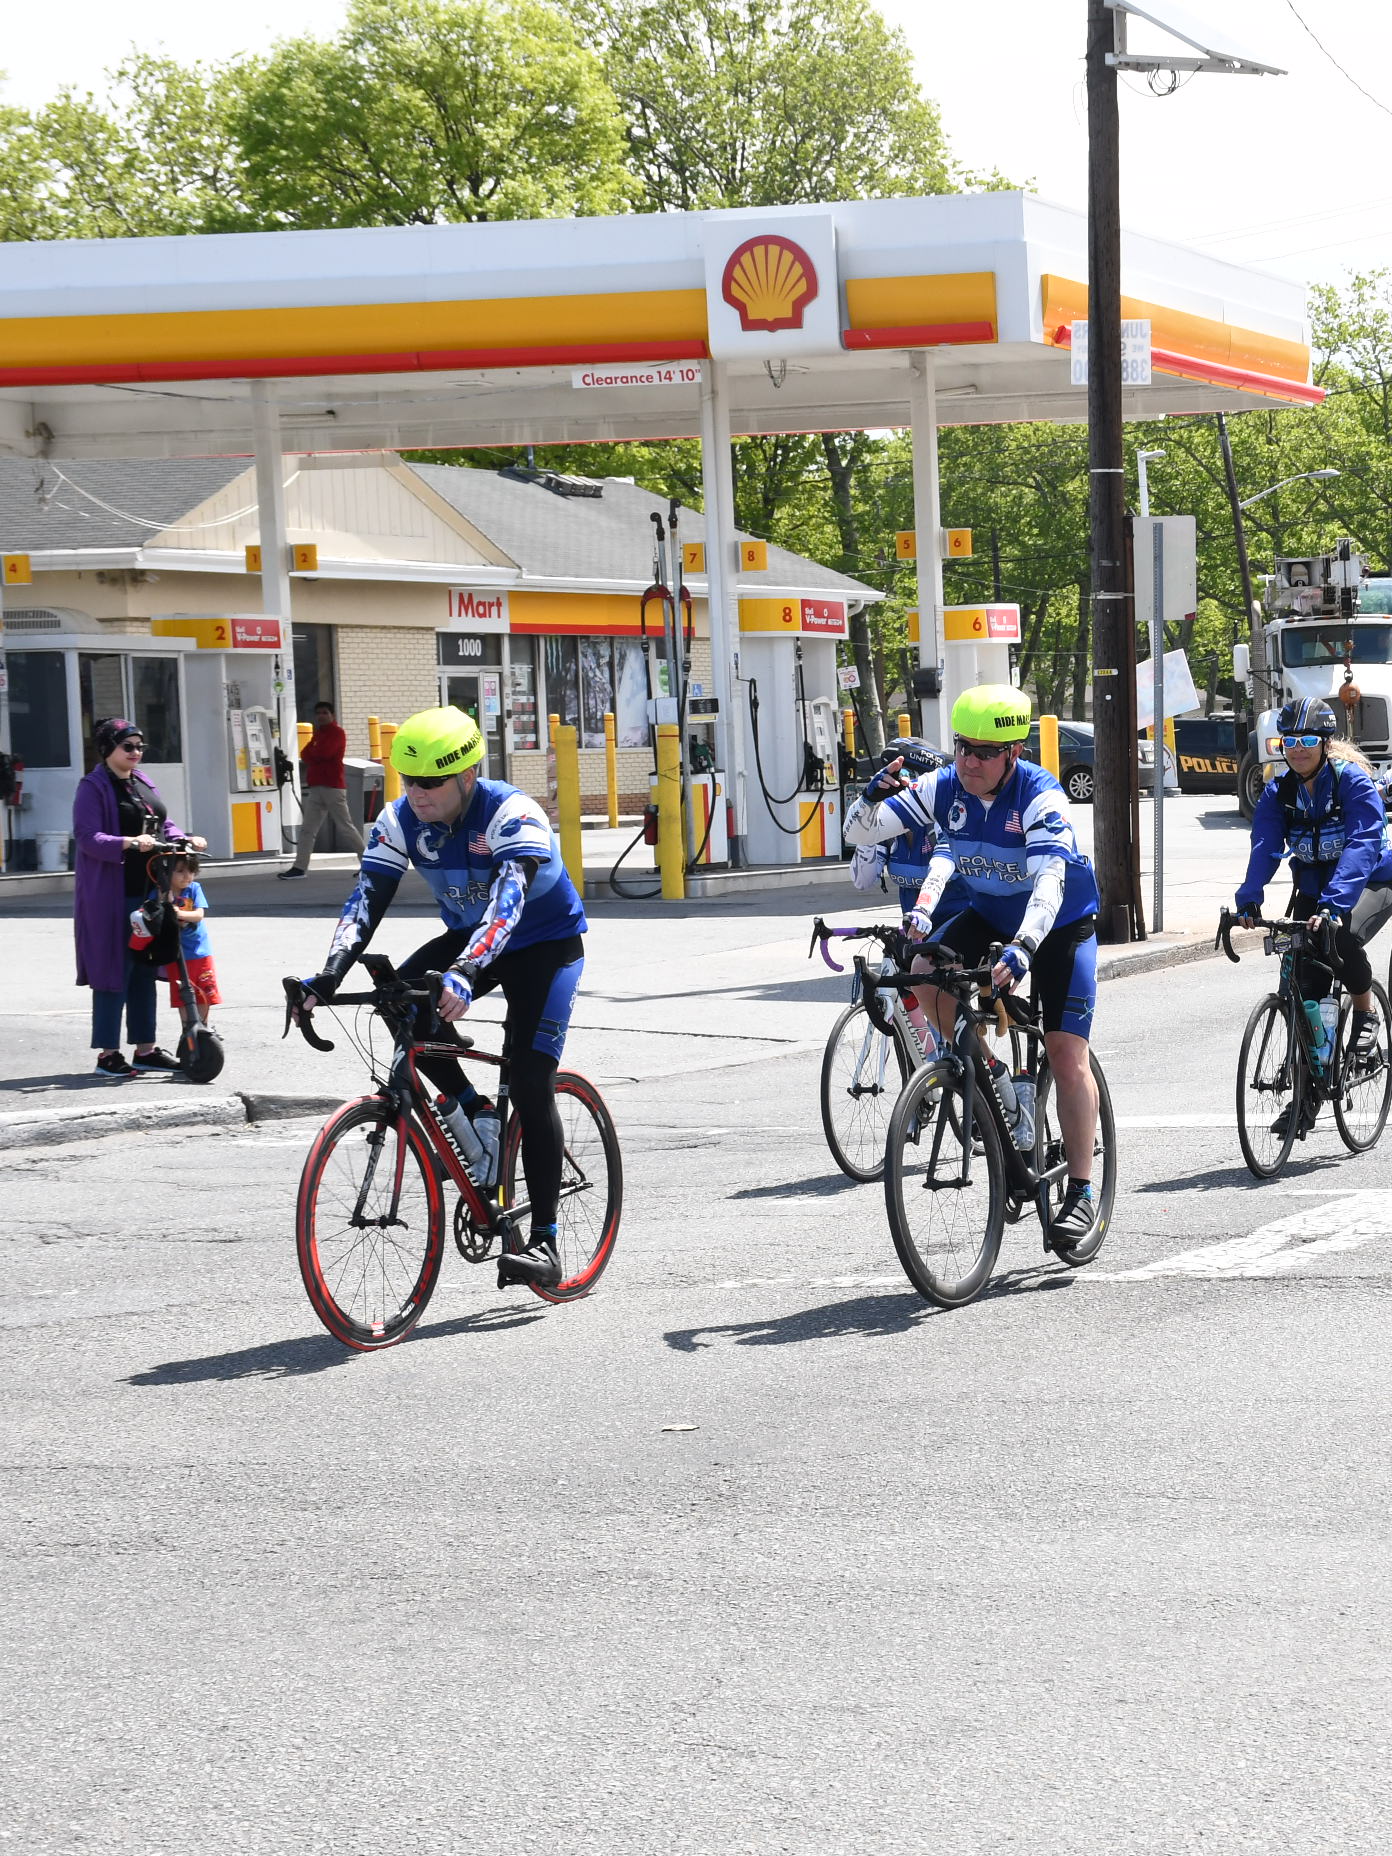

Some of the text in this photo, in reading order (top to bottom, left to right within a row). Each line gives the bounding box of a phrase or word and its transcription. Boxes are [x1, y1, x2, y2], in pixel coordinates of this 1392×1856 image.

[581, 368, 701, 387] Clearance 14' 10"
[903, 539, 910, 549] 5
[953, 537, 961, 548] 6
[252, 553, 258, 564] 1
[301, 552, 309, 564] 2
[689, 552, 698, 564] 7
[747, 550, 756, 562] 8
[8, 563, 17, 575] 4
[458, 592, 502, 619] Mart
[782, 606, 793, 623] 8
[972, 616, 982, 632] 6
[215, 625, 226, 641] 2
[458, 638, 482, 657] 1000
[994, 715, 1016, 729] RIDE
[434, 749, 462, 770] RIDE
[909, 752, 935, 766] UNITY
[959, 855, 1020, 873] POLICE
[957, 863, 1031, 883] NITY TOU
[890, 874, 925, 887] POLIC
